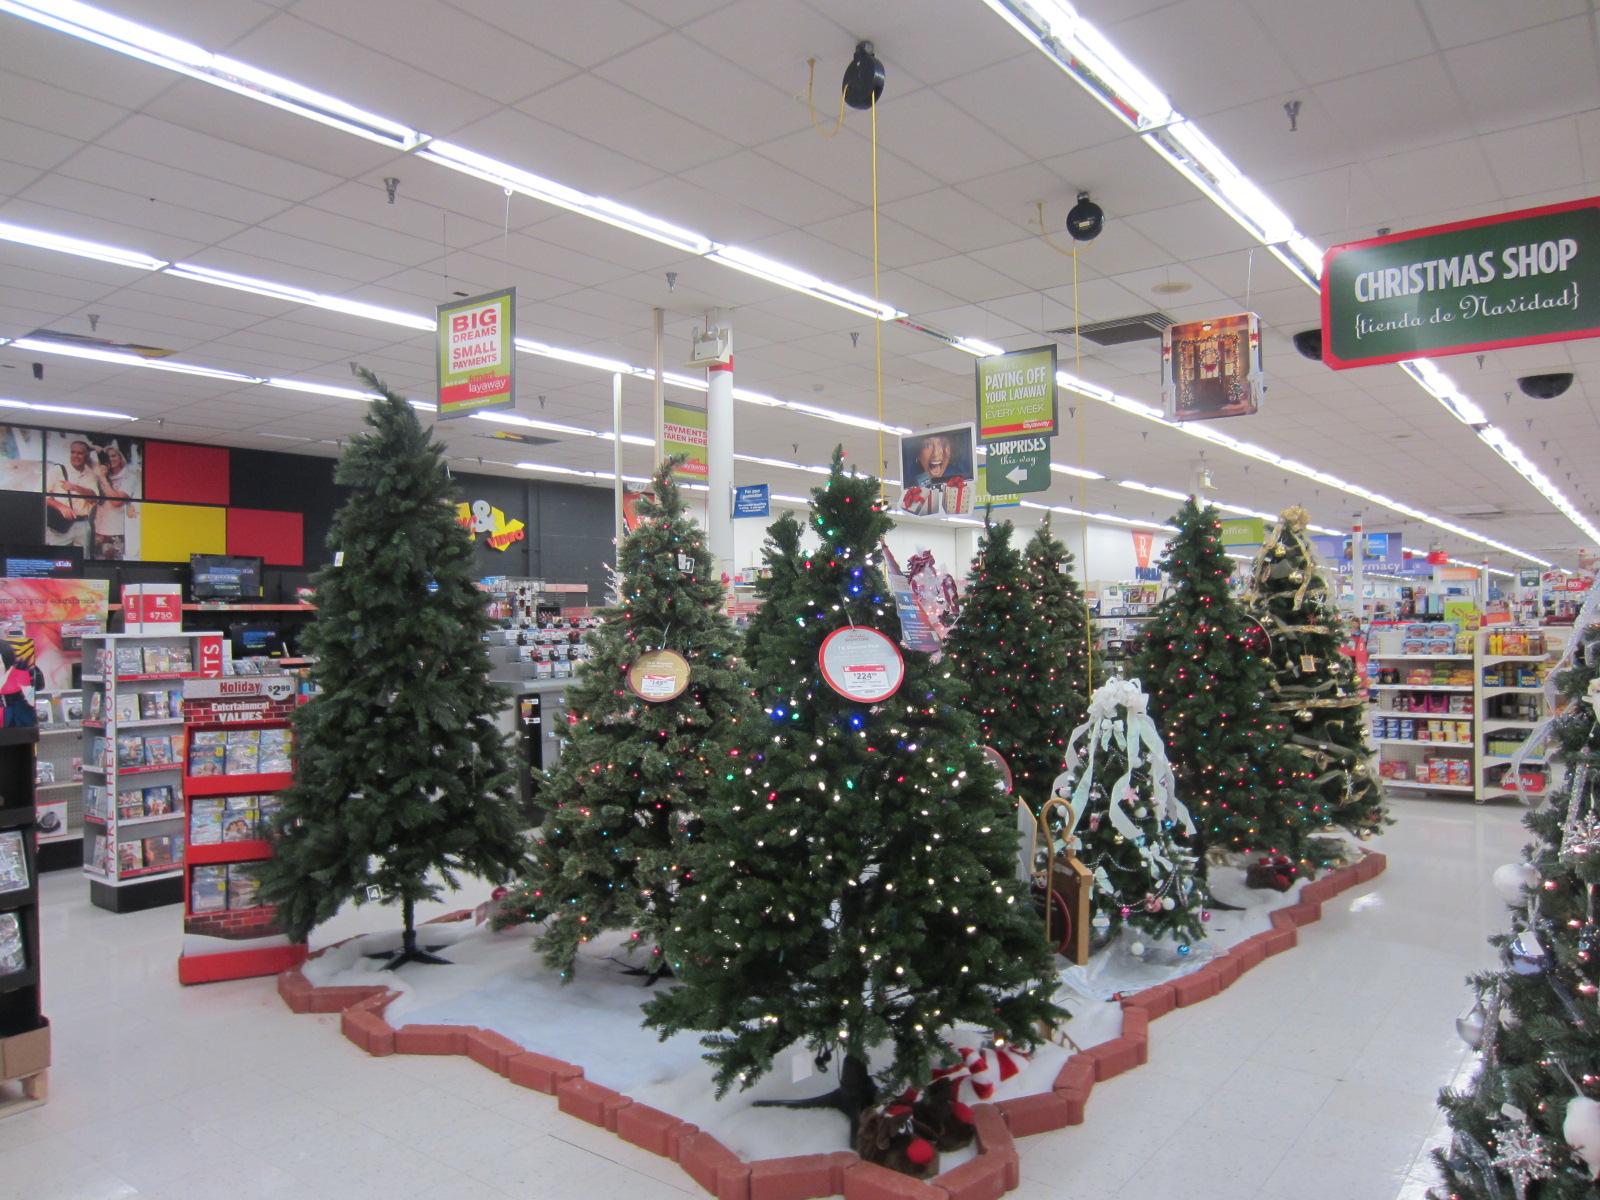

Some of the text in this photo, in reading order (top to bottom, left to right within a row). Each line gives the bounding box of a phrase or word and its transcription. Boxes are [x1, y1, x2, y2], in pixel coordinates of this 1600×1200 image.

[1354, 238, 1578, 303] CHRISTMAS SHOP
[452, 308, 497, 333] BIG
[1429, 308, 1456, 324] de
[453, 326, 497, 343] DREAMS
[453, 341, 497, 360] SMALL
[453, 354, 498, 370] PAYMENTS
[985, 370, 1024, 391] PAYING
[1026, 366, 1046, 385] OFF
[469, 379, 506, 394] layaway
[985, 384, 1046, 404] YOUR LAYAWAY
[985, 409, 1014, 419] EVERY
[664, 424, 707, 438] PAYMENTS
[1023, 421, 1050, 429] layaway
[664, 432, 707, 446] TAKEN HERE
[989, 437, 1047, 456] SURPRISES
[684, 464, 708, 472] ayaway
[1000, 455, 1036, 467] this way
[487, 529, 525, 548] VIDEO
[1339, 561, 1401, 575] phrmacy
[220, 682, 261, 695] Holiday
[211, 702, 269, 711] Entertainment
[219, 712, 263, 722] VALUES
[104, 650, 116, 874] MAKE THEM YOURS
